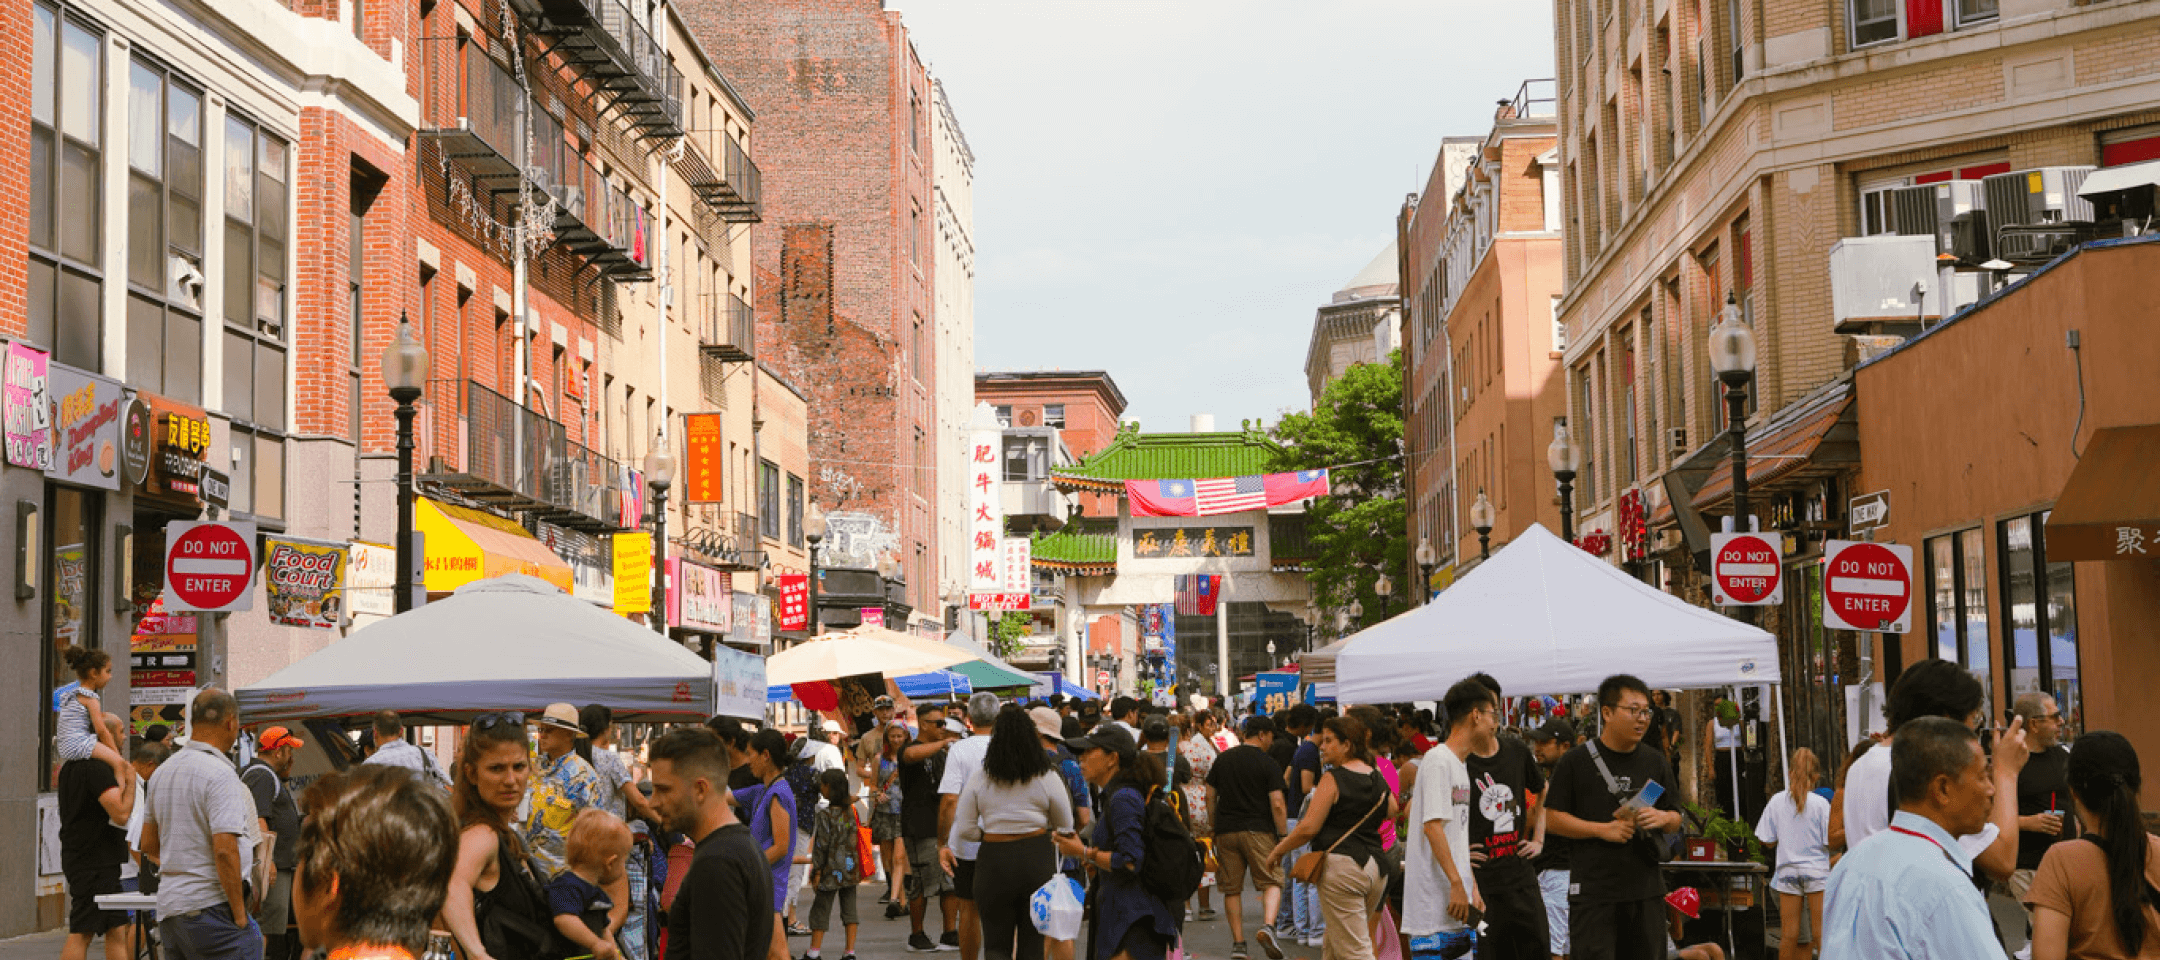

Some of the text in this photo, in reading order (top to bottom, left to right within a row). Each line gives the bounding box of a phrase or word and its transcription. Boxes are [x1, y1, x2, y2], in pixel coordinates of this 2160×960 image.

[974, 444, 996, 581] 肥牛火鍋城
[184, 540, 238, 555] DO NOT
[2115, 526, 2160, 555] 聚
[271, 546, 336, 571] Food
[1724, 550, 1771, 563] DO NOT
[1840, 560, 1895, 576] DO NOT
[273, 565, 333, 589] Court
[1729, 577, 1767, 588] ENTER
[185, 578, 232, 593] ENTER
[974, 594, 1025, 602] HOT POT
[1844, 597, 1890, 612] ENTER
